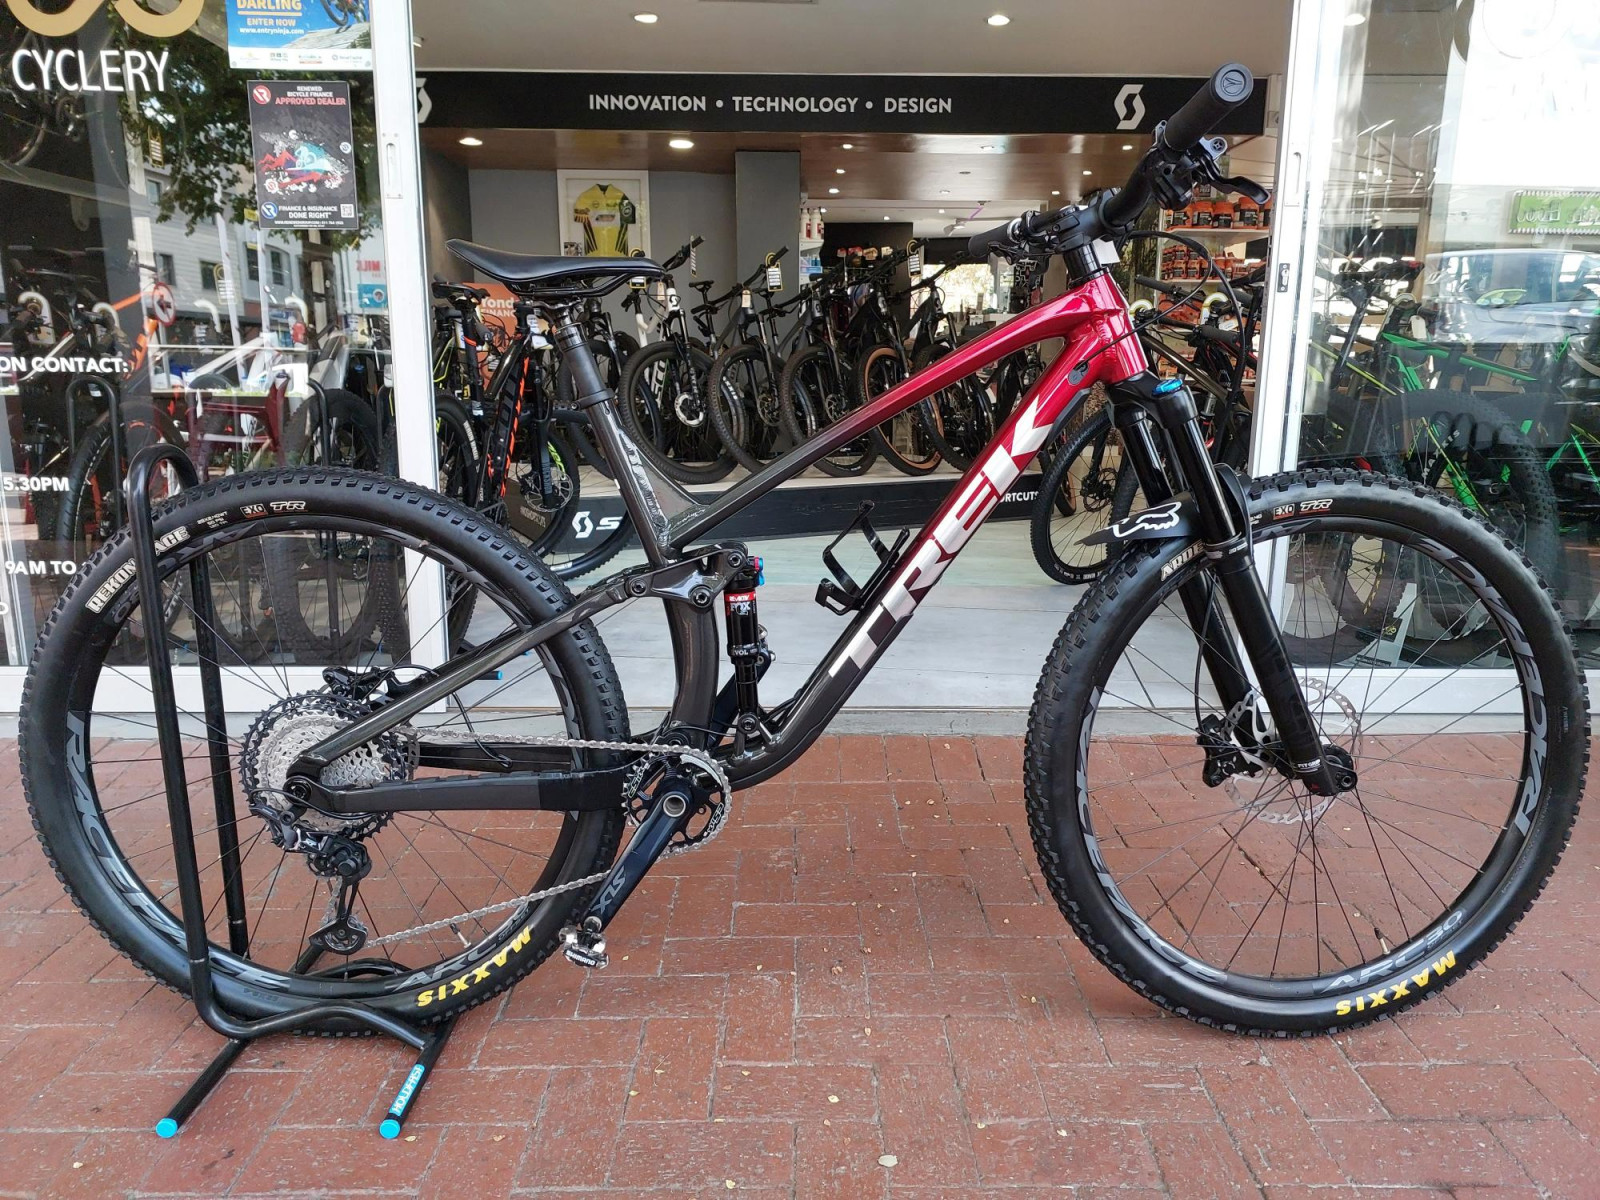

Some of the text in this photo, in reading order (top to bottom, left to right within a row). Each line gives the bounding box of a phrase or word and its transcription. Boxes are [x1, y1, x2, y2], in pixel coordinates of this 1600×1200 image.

[236, 0, 302, 10] DARLING
[240, 27, 304, 35] www.entryninja.com
[247, 18, 296, 27] ENTER NOW
[12, 49, 169, 92] CYCLERY
[275, 97, 316, 105] APPROVED
[589, 94, 952, 114] INNOVATION TECHNOLOGY DESIGN
[31, 357, 129, 373] CONTACT:
[3, 477, 70, 492] 5.30PM
[240, 500, 307, 518] EXO TR
[1273, 503, 1295, 519] EXO
[1300, 498, 1333, 512] TR
[828, 394, 1053, 678] TREK
[5, 560, 77, 575] 9AM TO
[85, 526, 192, 614] REKON ACE
[1160, 540, 1205, 582] ARDE
[590, 864, 627, 914] SLX
[416, 925, 532, 1007] MAXXIS
[565, 949, 596, 966] SHIMANO
[1335, 950, 1457, 1016] MAXXIS
